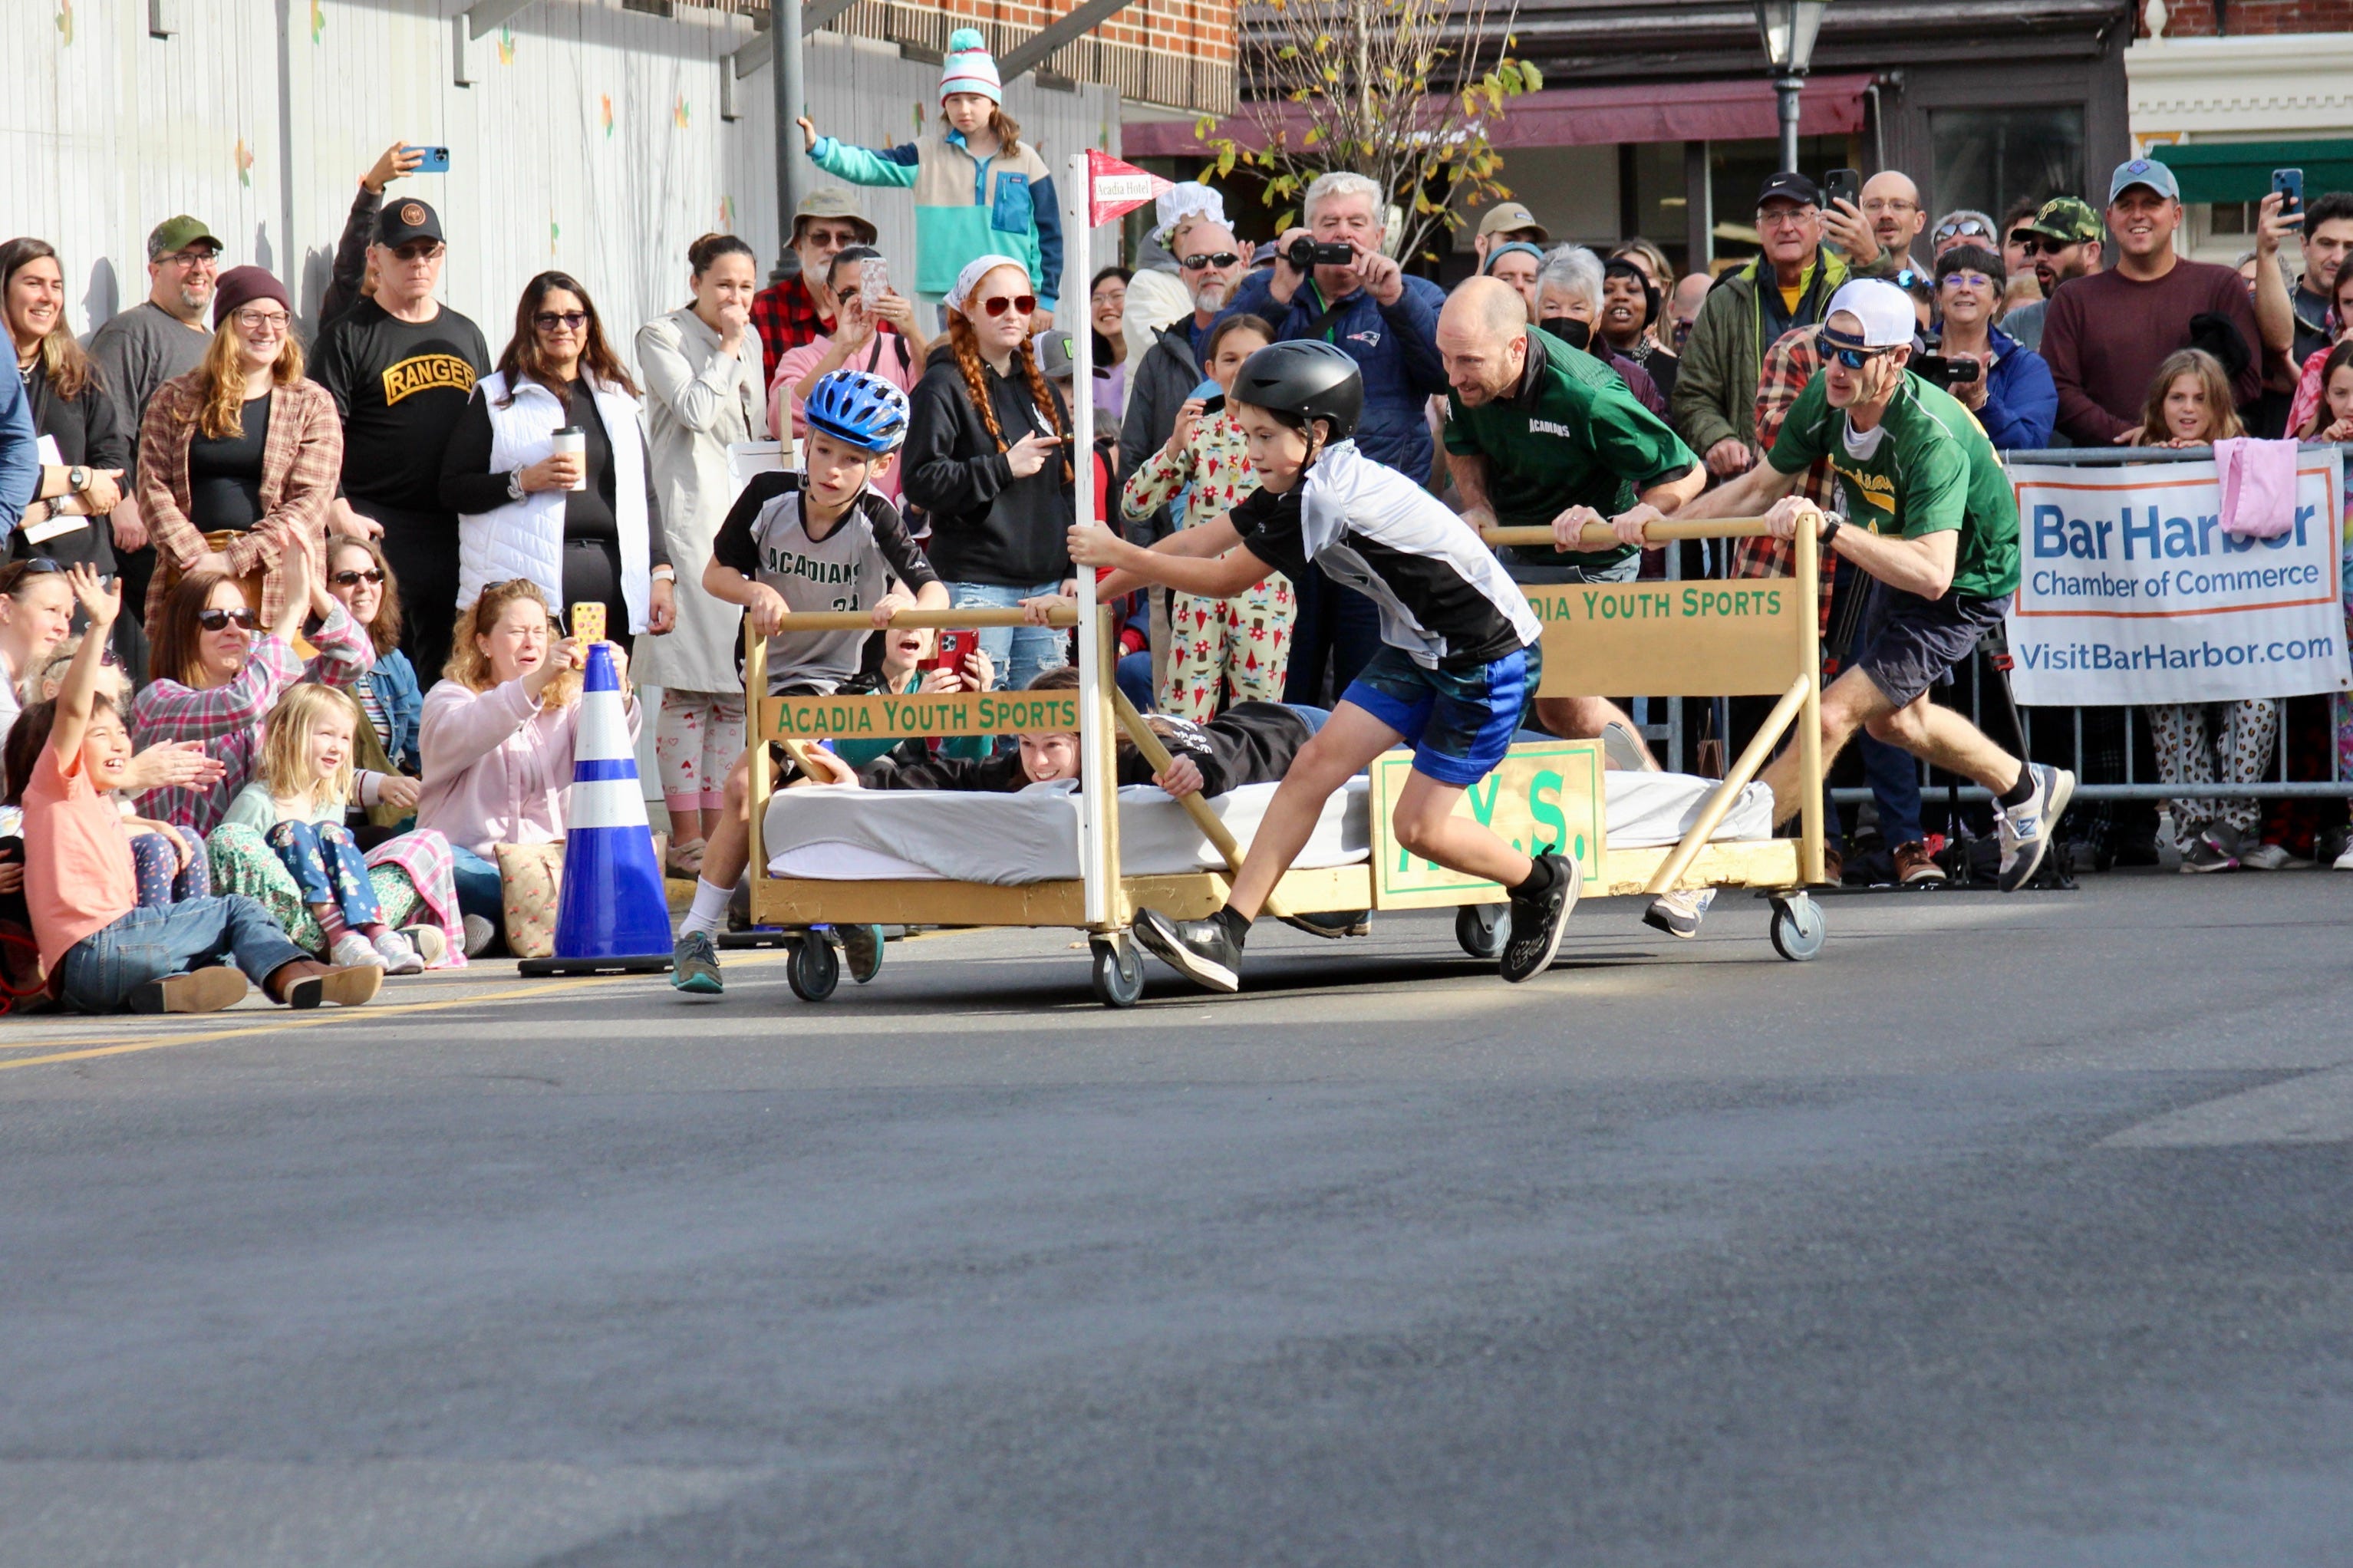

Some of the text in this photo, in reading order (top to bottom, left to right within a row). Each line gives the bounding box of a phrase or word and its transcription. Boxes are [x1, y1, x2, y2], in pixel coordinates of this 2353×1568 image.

[1098, 180, 1148, 196] Acadia Hotel
[388, 359, 474, 397] RANGER
[1529, 417, 1570, 438] ACADIANS
[2033, 504, 2113, 561] Bar
[2032, 564, 2319, 598] Chamber of Commerce
[1583, 591, 1671, 621] YOUTH
[1682, 588, 1781, 617] SPORTS
[2019, 636, 2334, 670] VisitBarHarbor.com
[777, 698, 1076, 733] ACADIA YOUTH SPORTS
